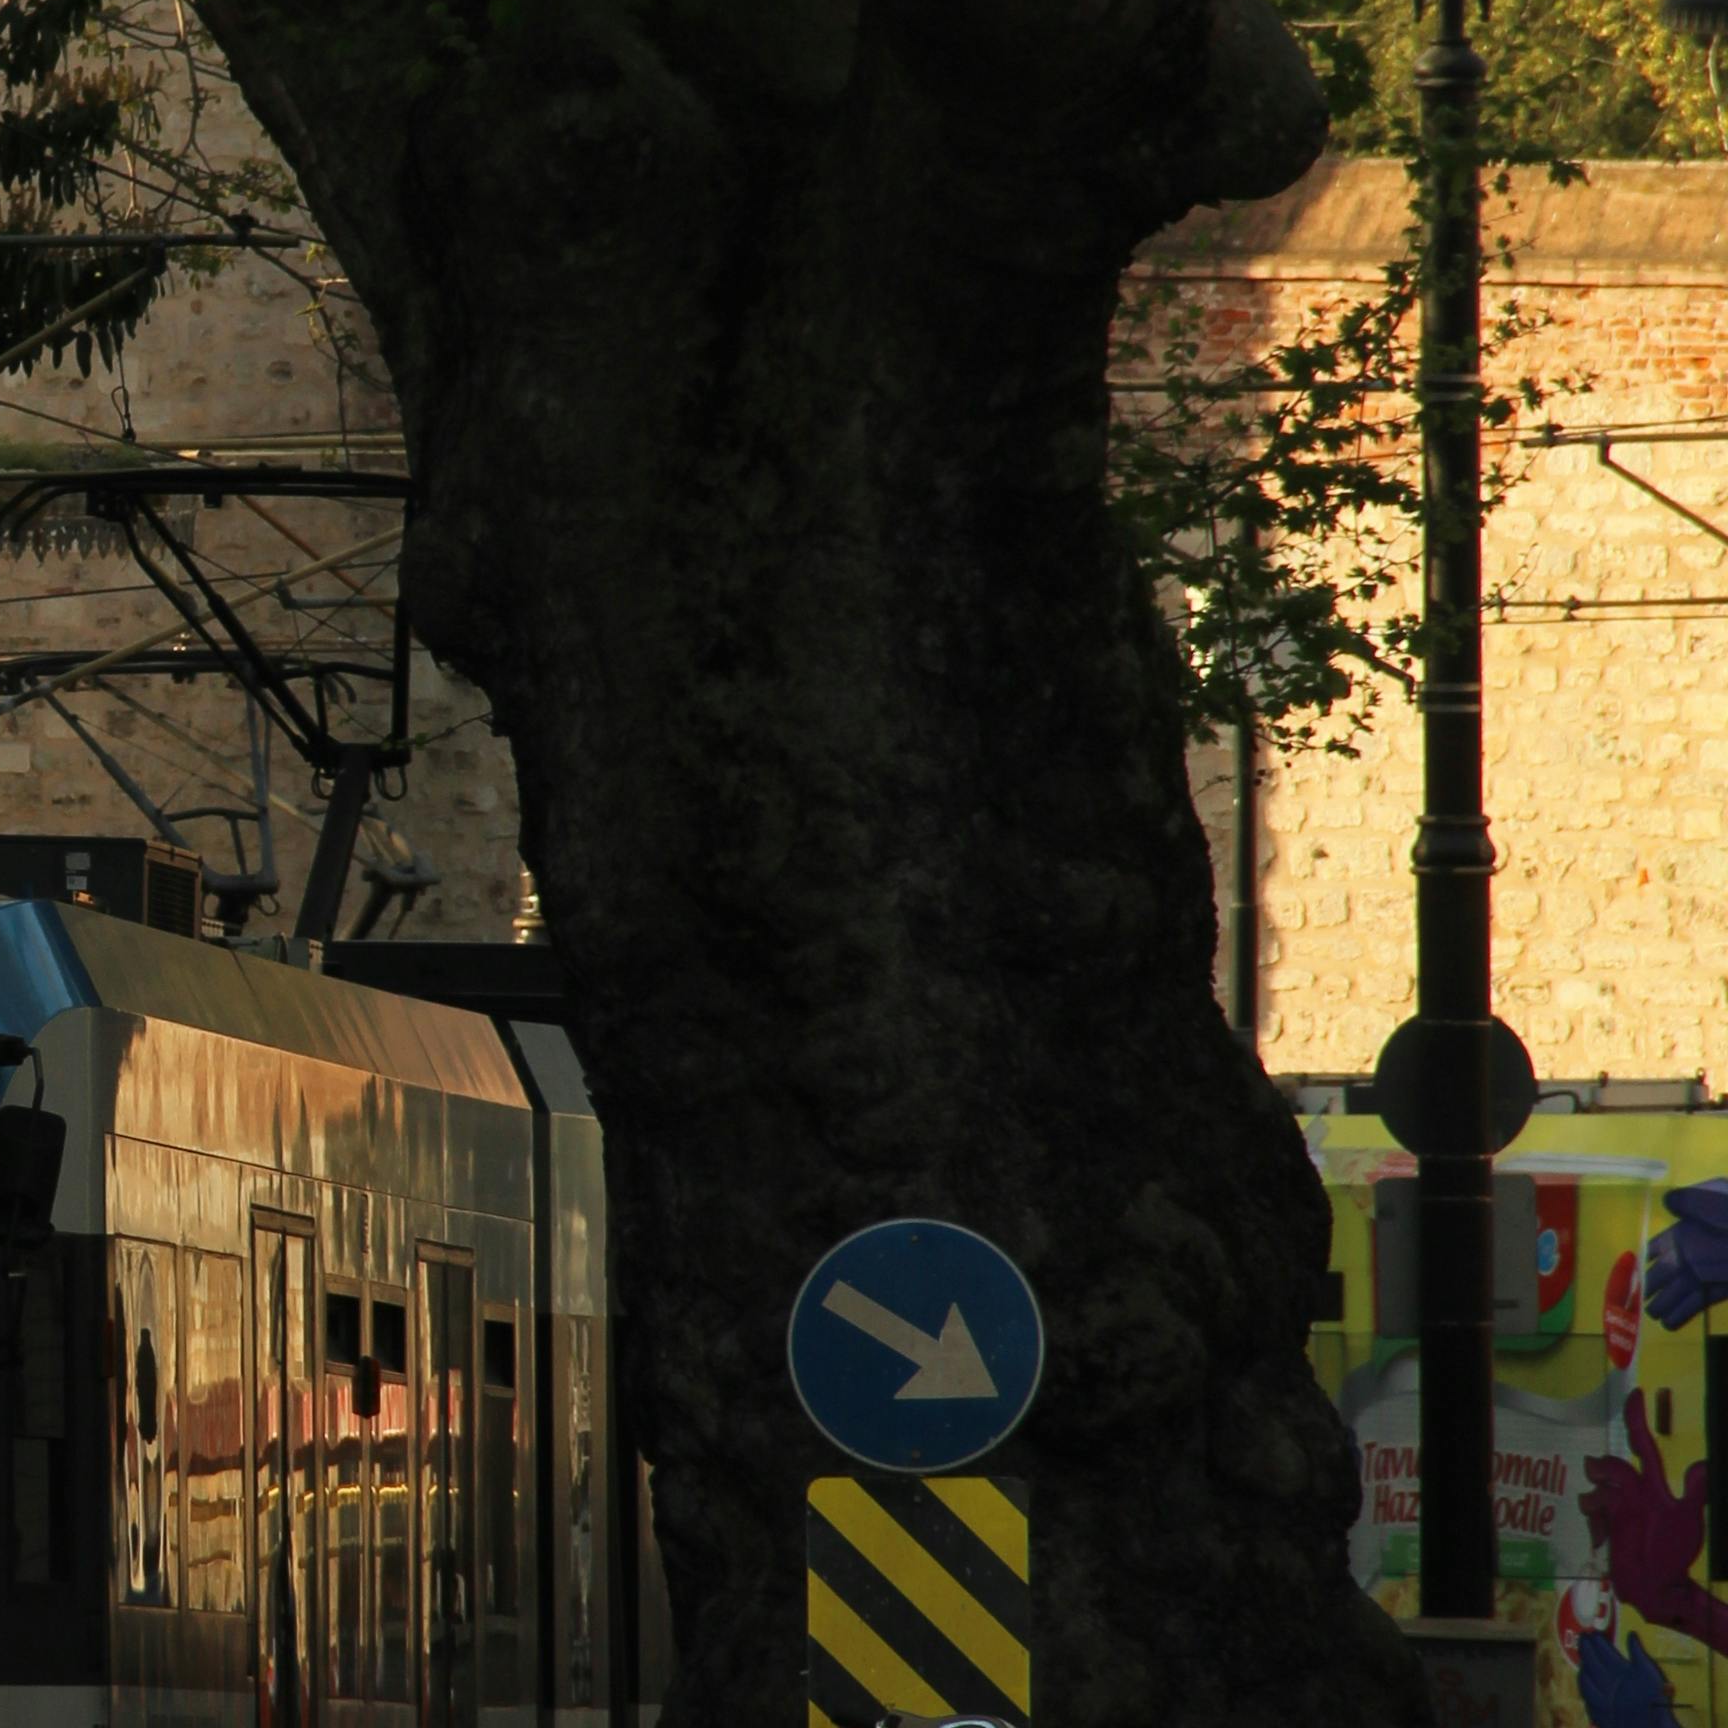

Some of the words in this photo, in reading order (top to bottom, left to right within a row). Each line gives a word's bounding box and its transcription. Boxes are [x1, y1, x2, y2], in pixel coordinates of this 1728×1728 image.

[1364, 1441, 1421, 1482] Tavu
[1373, 1485, 1421, 1525] Haz
[1492, 1493, 1554, 1536] odle
